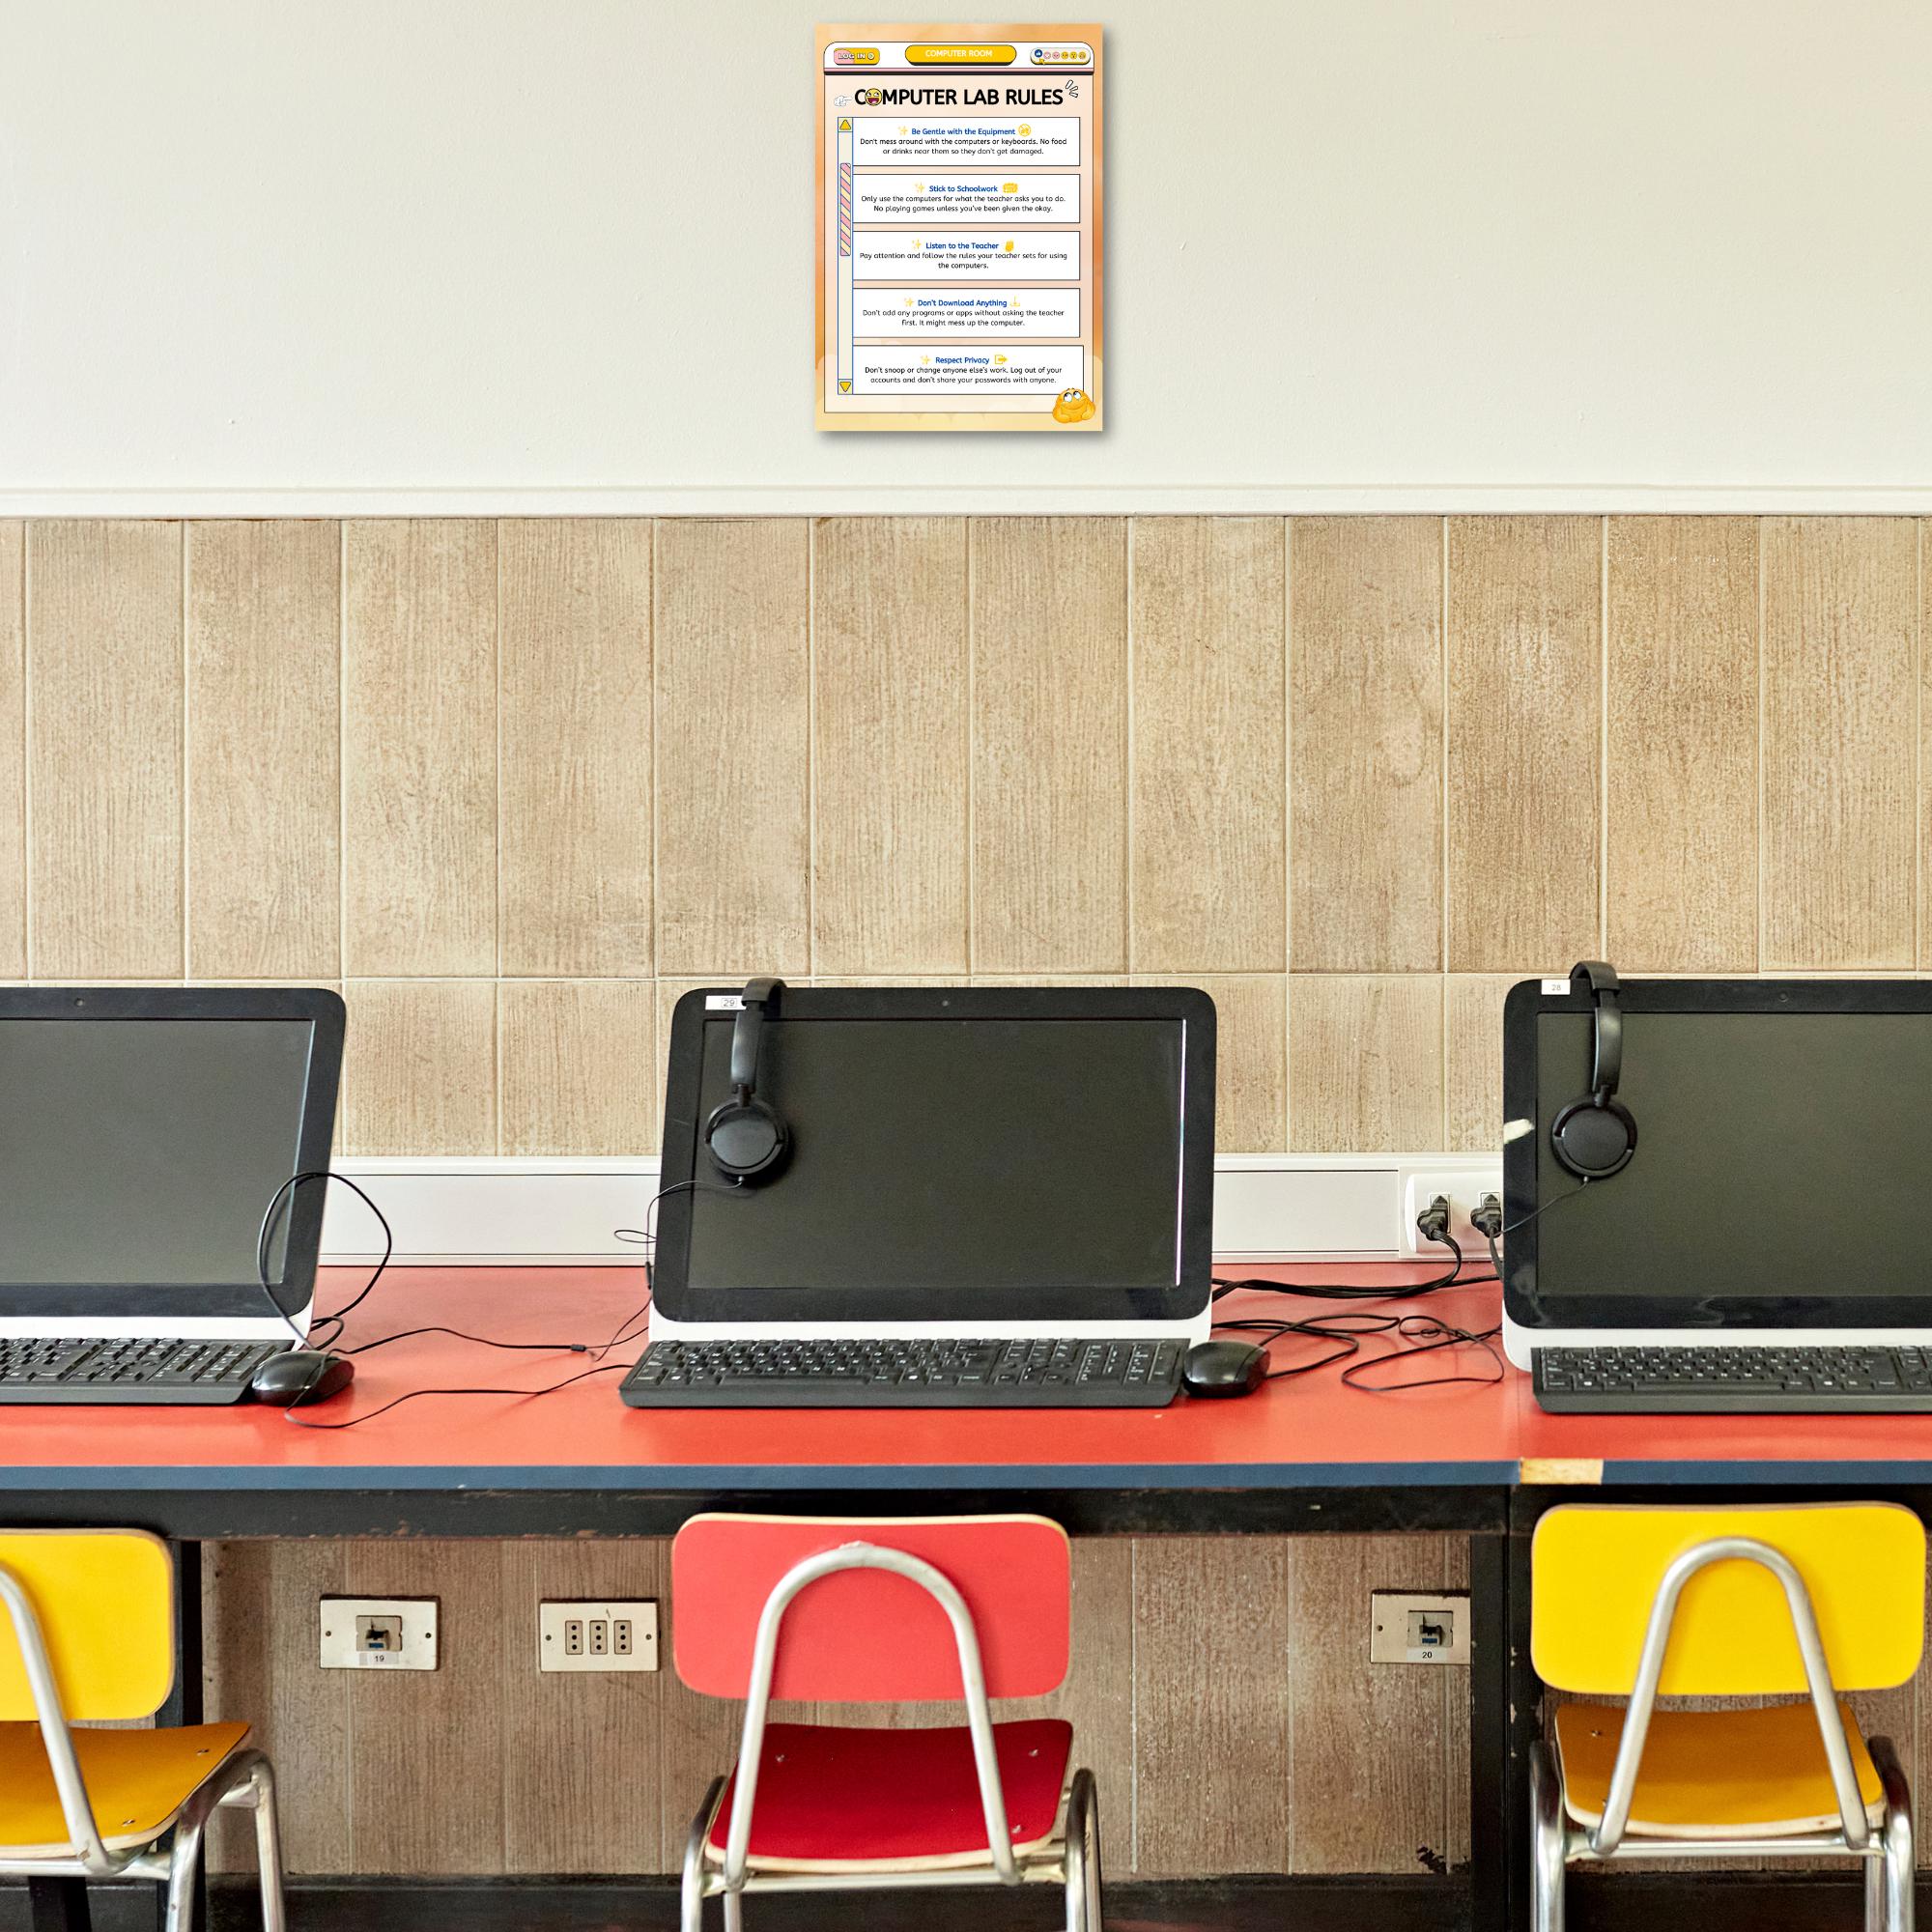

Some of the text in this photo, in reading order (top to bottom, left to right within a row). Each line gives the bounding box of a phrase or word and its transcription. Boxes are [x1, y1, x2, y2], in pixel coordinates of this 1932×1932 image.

[924, 49, 993, 58] COMPUTER ROOM
[963, 88, 1000, 105] LAB
[1006, 88, 1064, 105] RULES
[978, 128, 1016, 137] Equipment
[960, 148, 977, 156] they
[996, 148, 1008, 156] get
[1009, 148, 1044, 156] damaged.
[861, 195, 878, 204] Only
[885, 205, 911, 213] playing
[959, 205, 982, 213] you've
[1001, 205, 1020, 213] given
[1034, 205, 1053, 213] okay.
[860, 252, 872, 261] Pay
[918, 298, 937, 307] Don't
[976, 299, 1008, 308] Anything
[1002, 309, 1024, 318] asking
[925, 319, 947, 327] might
[935, 356, 990, 365] Respect Privacy
[1010, 367, 1023, 376] Log
[723, 998, 735, 1007] 29
